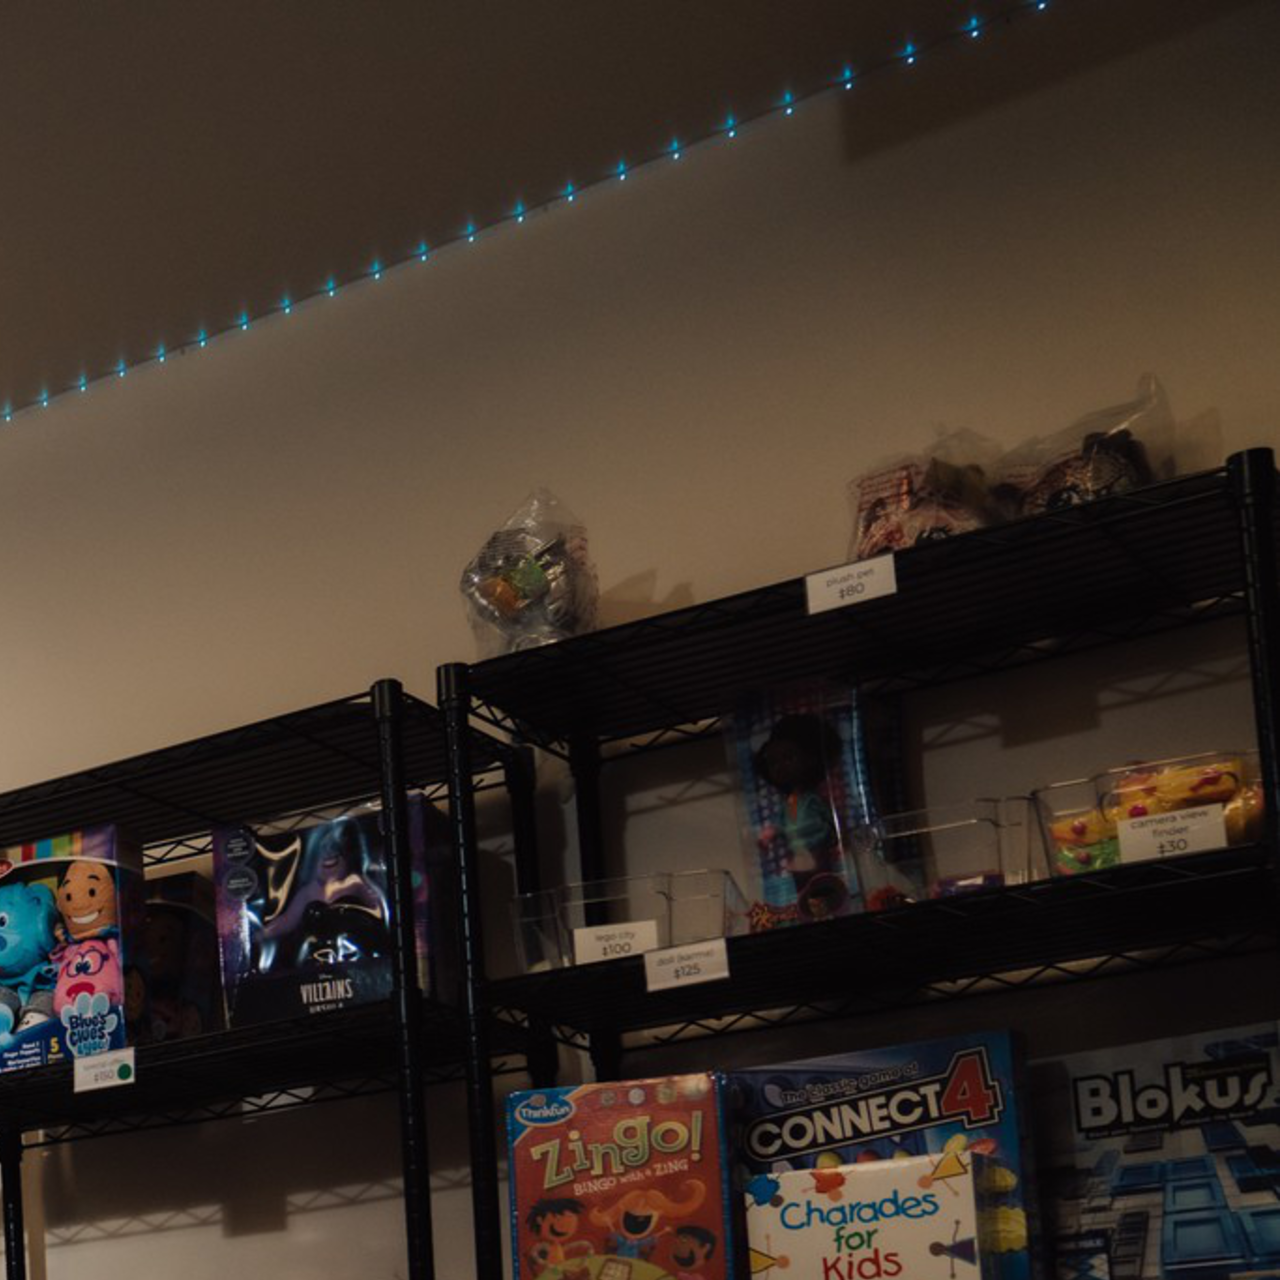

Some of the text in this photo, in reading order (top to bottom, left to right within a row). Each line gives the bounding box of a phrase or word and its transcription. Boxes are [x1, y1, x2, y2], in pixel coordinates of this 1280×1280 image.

[826, 568, 875, 588] plush pet
[1130, 810, 1208, 831] camera view
[1151, 825, 1189, 839] finder
[594, 931, 635, 945] lego city
[655, 956, 675, 968] doll
[299, 979, 354, 1004] VILLAINS
[50, 1037, 62, 1051] 5
[781, 1061, 919, 1104] The classic game of
[1076, 1060, 1271, 1131] Blokus
[750, 1053, 994, 1150] CONNECT 4
[530, 1110, 704, 1191] Zingo!
[573, 1158, 689, 1196] BINGO with ZING
[780, 1189, 940, 1231] Charades
[833, 1225, 878, 1253] for
